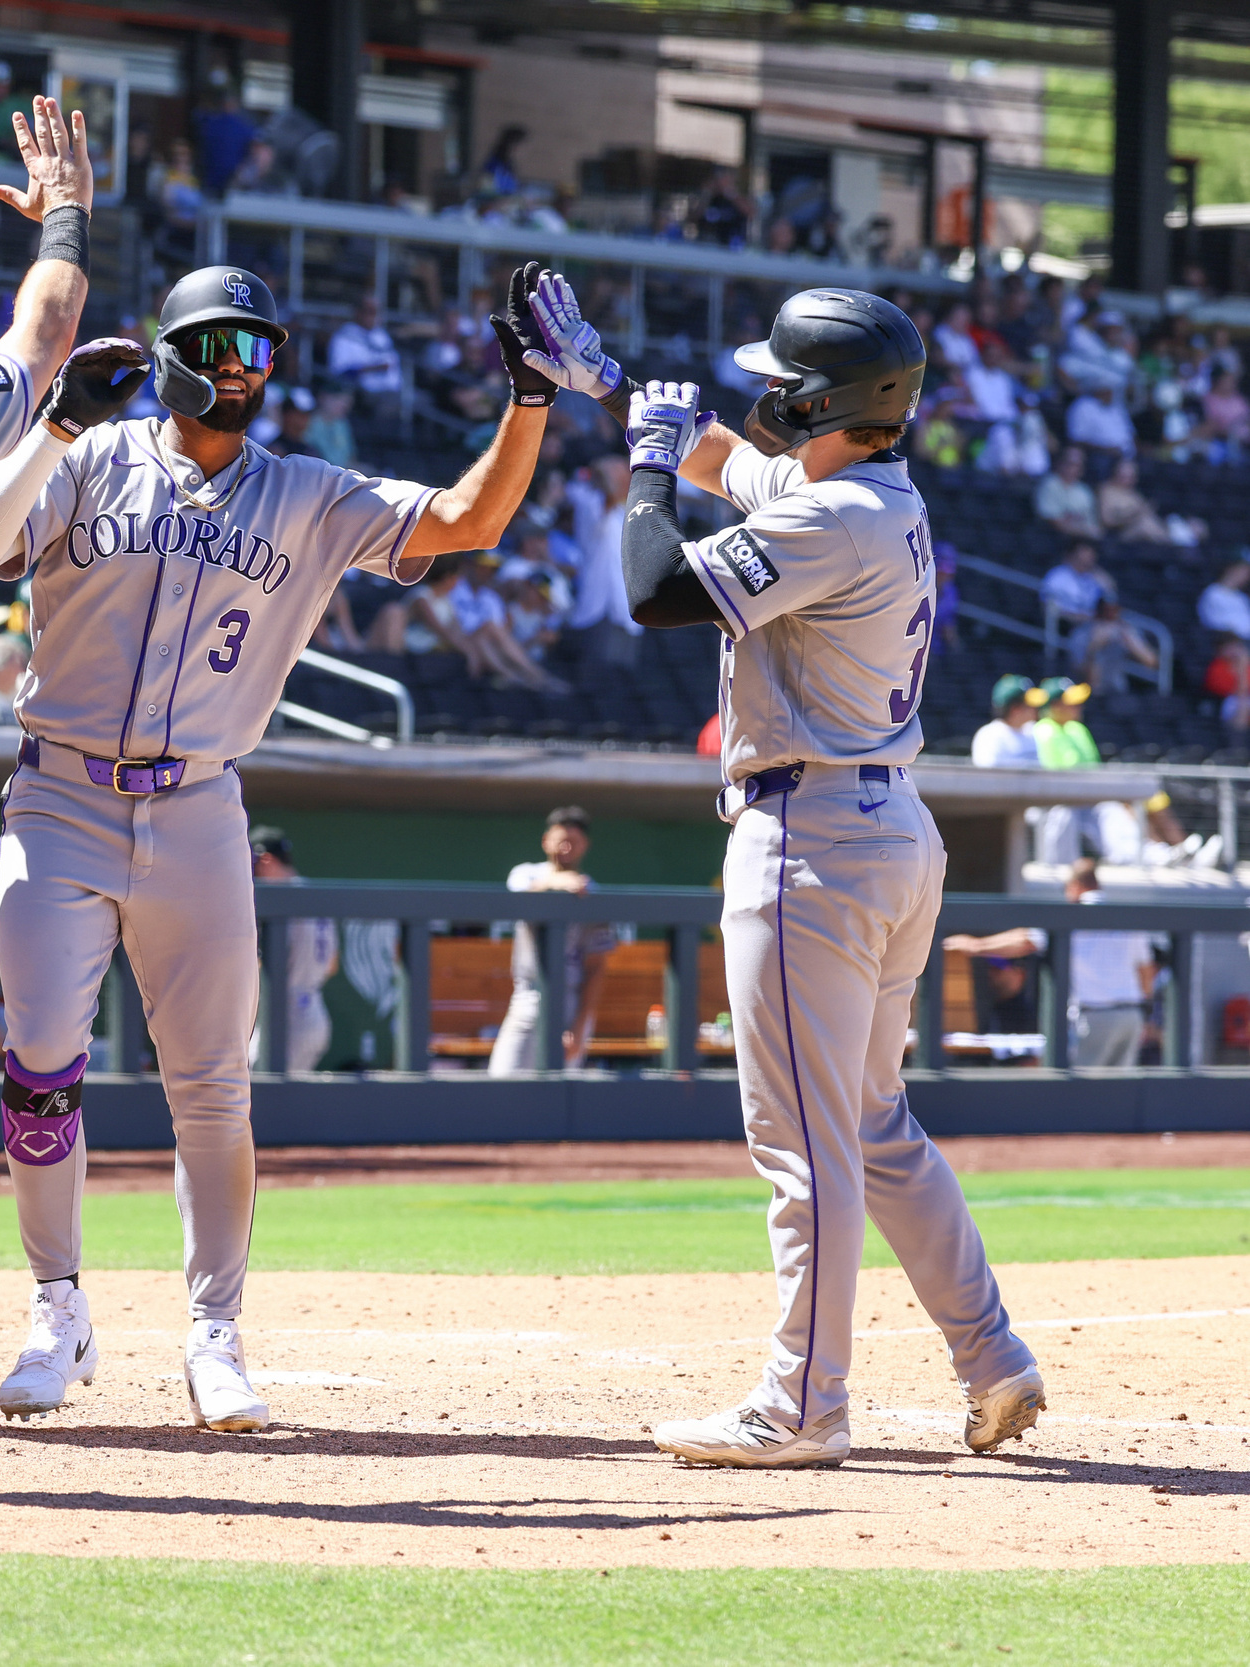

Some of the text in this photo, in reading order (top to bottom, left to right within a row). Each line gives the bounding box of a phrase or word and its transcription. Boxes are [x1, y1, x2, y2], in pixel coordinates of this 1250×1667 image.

[222, 272, 254, 308] CR
[67, 512, 291, 596] COLORADO
[724, 545, 742, 565] SPACE
[729, 532, 774, 588] YORK
[738, 563, 762, 592] SYSTEMS
[207, 608, 251, 675] 3
[163, 770, 171, 786] 3
